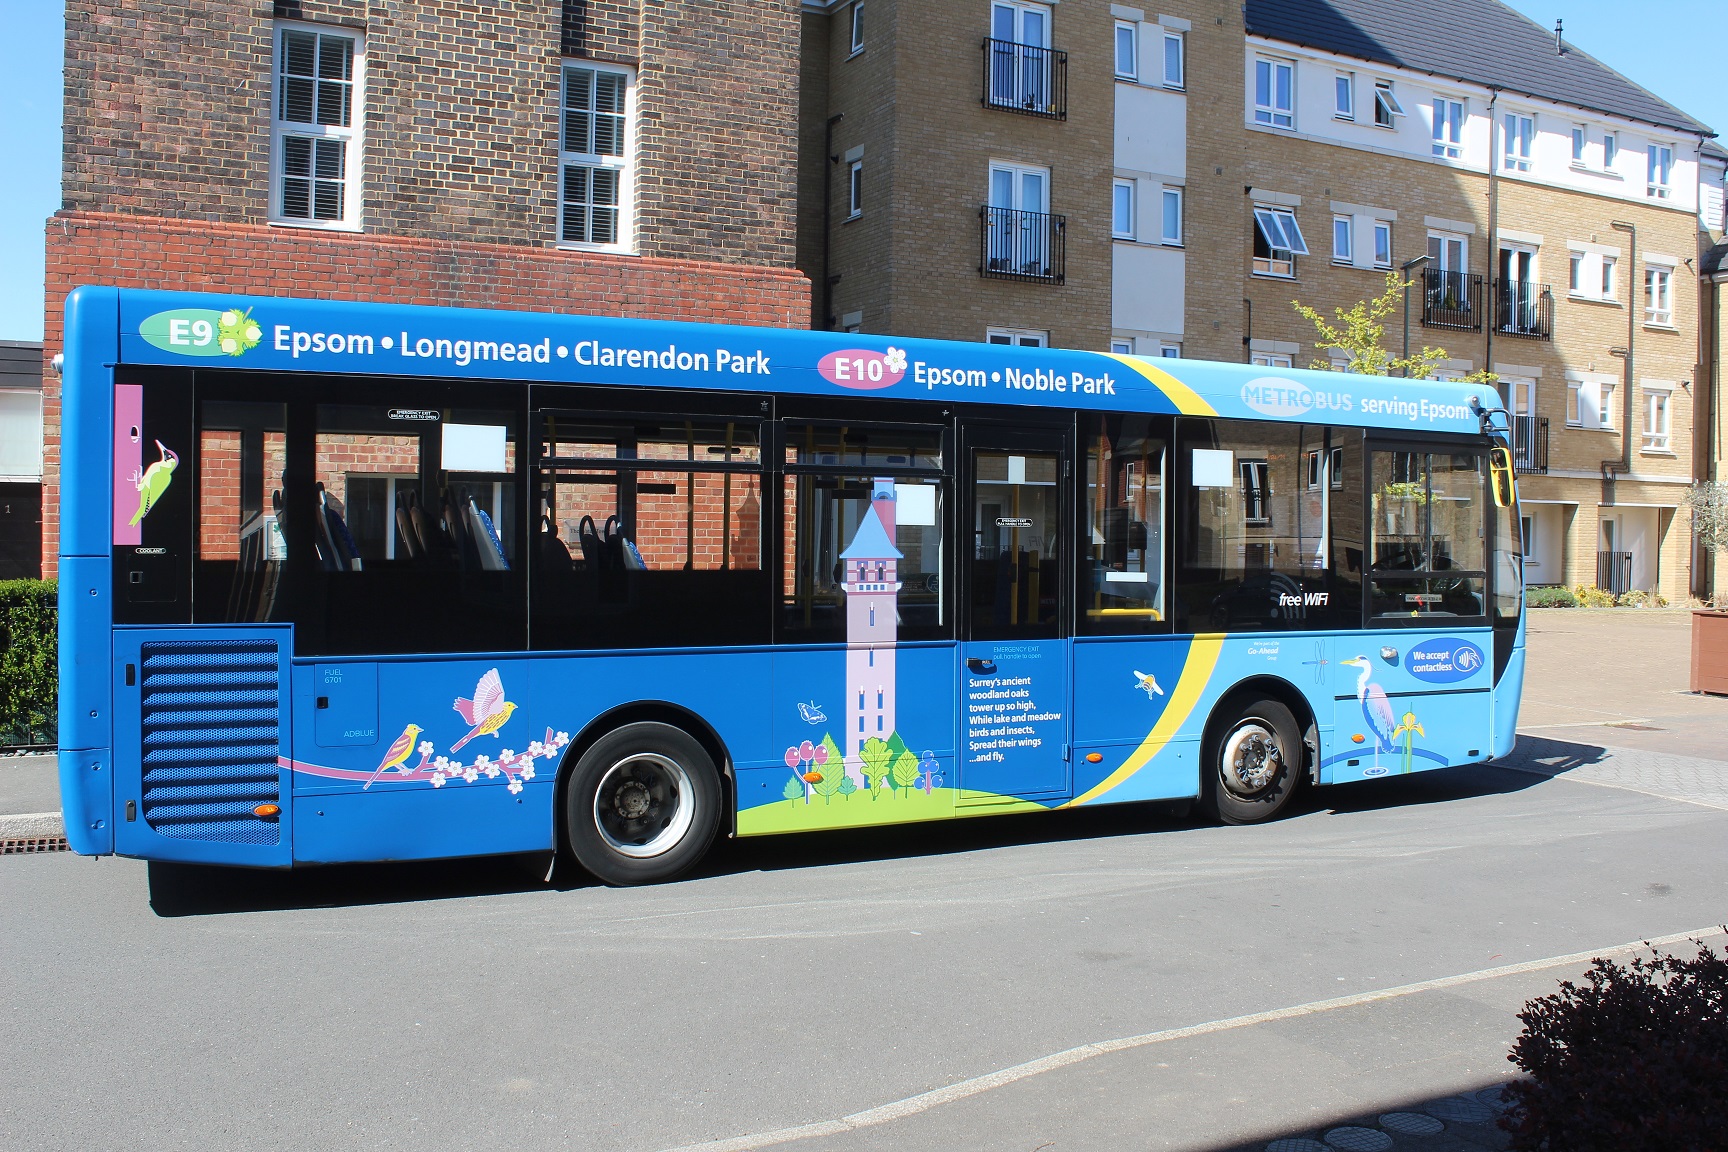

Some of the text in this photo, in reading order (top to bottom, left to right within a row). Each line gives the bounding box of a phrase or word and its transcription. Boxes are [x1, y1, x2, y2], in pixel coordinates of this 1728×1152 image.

[169, 319, 213, 347] E9
[273, 325, 771, 375] Epsom Longmead Clarendon Park
[834, 357, 883, 382] E10
[914, 362, 1116, 396] Epsom Noble Park
[1244, 386, 1352, 411] METROBUS
[1361, 395, 1469, 422] serving Epsom
[1279, 592, 1329, 606] free WiFi
[1247, 647, 1279, 655] Go-Ahead
[1413, 650, 1449, 661] We accept
[324, 668, 343, 676] FUEL
[1413, 662, 1453, 673] contactless
[324, 676, 342, 684] 6701
[969, 676, 1031, 689] Surrey's ancient
[969, 688, 1030, 700] woodland oaks
[969, 700, 1037, 714] tower up so high,
[969, 711, 1061, 725] While lake and meadow
[343, 729, 375, 738] ADBLUE
[969, 725, 1035, 738] birds and insects,
[969, 737, 1042, 752] Spread their wings
[992, 751, 1005, 763] fly.
